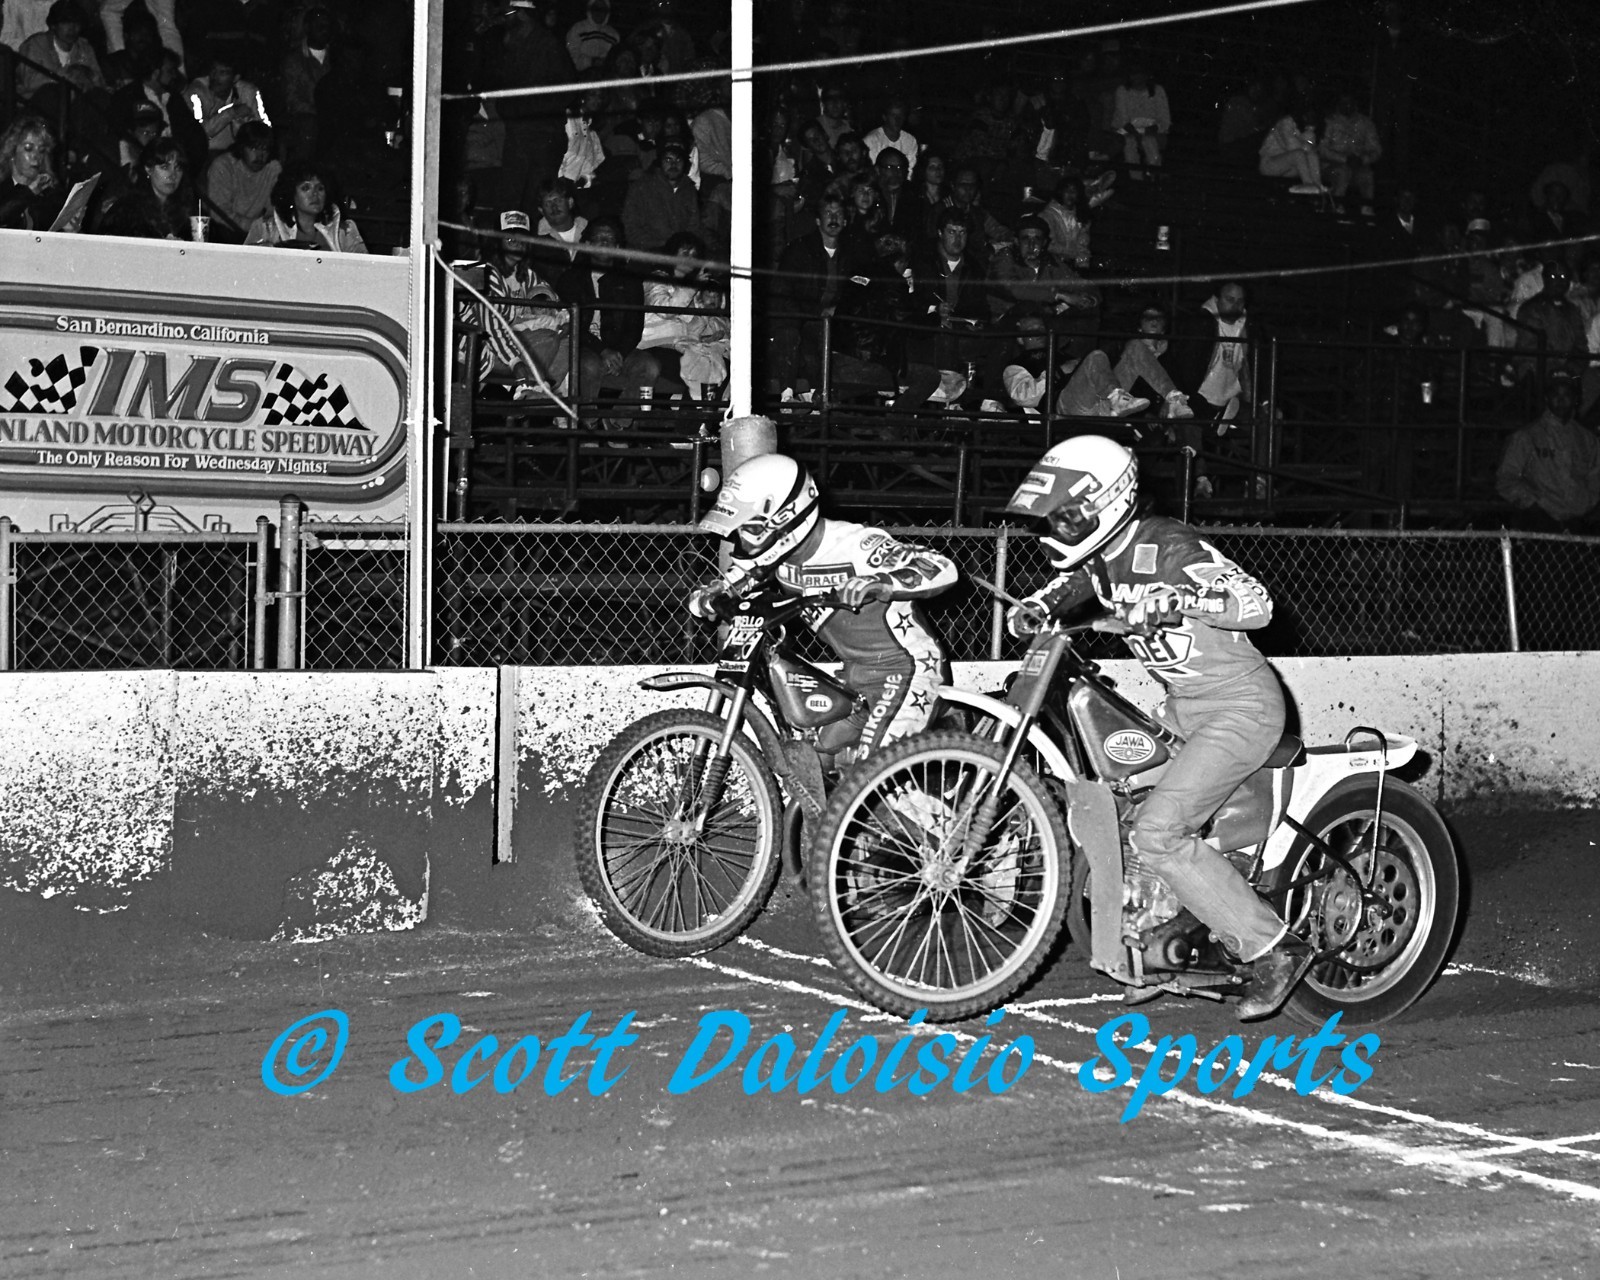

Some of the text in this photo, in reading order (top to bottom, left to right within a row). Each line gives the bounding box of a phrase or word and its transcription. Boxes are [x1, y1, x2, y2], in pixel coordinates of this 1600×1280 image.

[56, 316, 270, 345] San Bernardino, California
[86, 347, 276, 423] IMS
[94, 422, 256, 451] MOTORCYCLE
[261, 430, 379, 456] SPEEDWAY
[66, 451, 101, 468] Only
[104, 451, 160, 467] Reason
[164, 453, 189, 468] For
[195, 454, 275, 474] Wednesday
[805, 574, 846, 587] BRACE
[810, 700, 828, 708] BELL
[1115, 736, 1145, 748] JAWA
